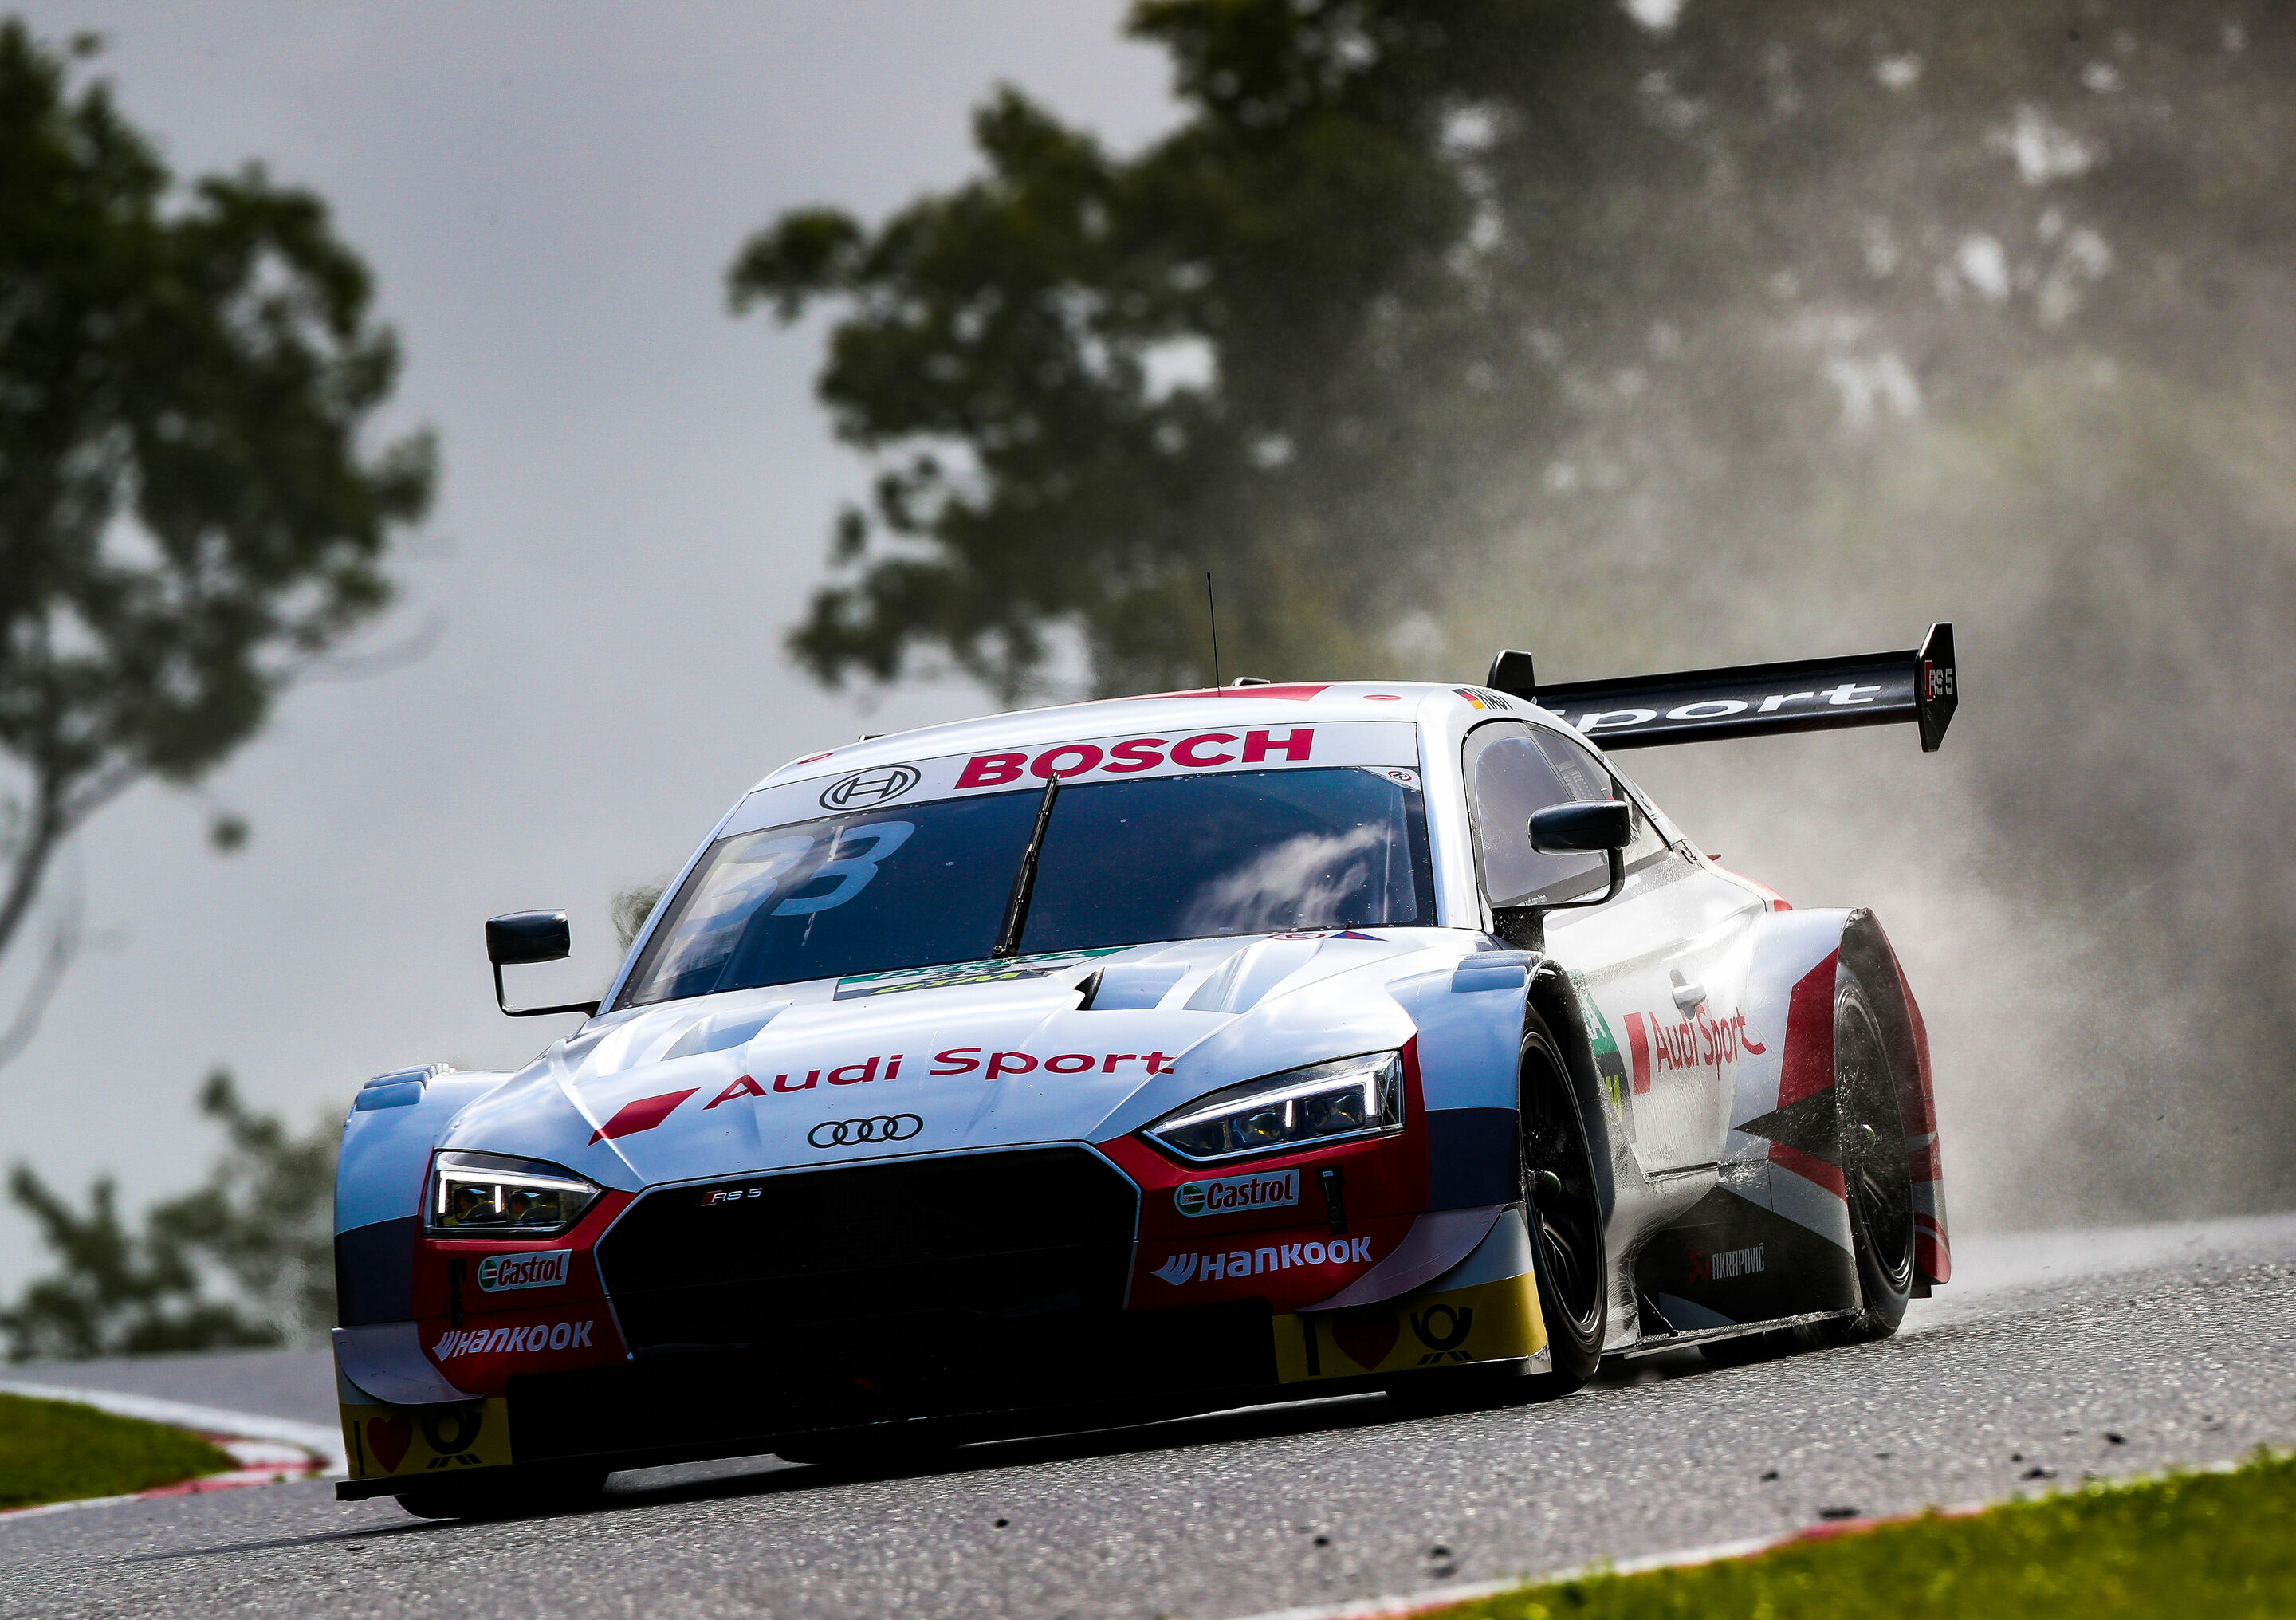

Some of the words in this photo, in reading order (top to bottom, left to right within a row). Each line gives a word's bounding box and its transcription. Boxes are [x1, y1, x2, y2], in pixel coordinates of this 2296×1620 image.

[1549, 683, 1881, 733] port
[954, 729, 1314, 789] BOSCH
[674, 820, 915, 938] 33
[870, 970, 1024, 995] DTM
[1649, 1009, 1700, 1073] Audi
[1696, 1002, 1767, 1082] Sport
[702, 1053, 905, 1111] Audi
[929, 1047, 1178, 1081] Sport
[710, 1190, 743, 1203] RS
[747, 1187, 763, 1197] 5
[1206, 1174, 1294, 1210] Castrol
[497, 1253, 563, 1287] Castrol
